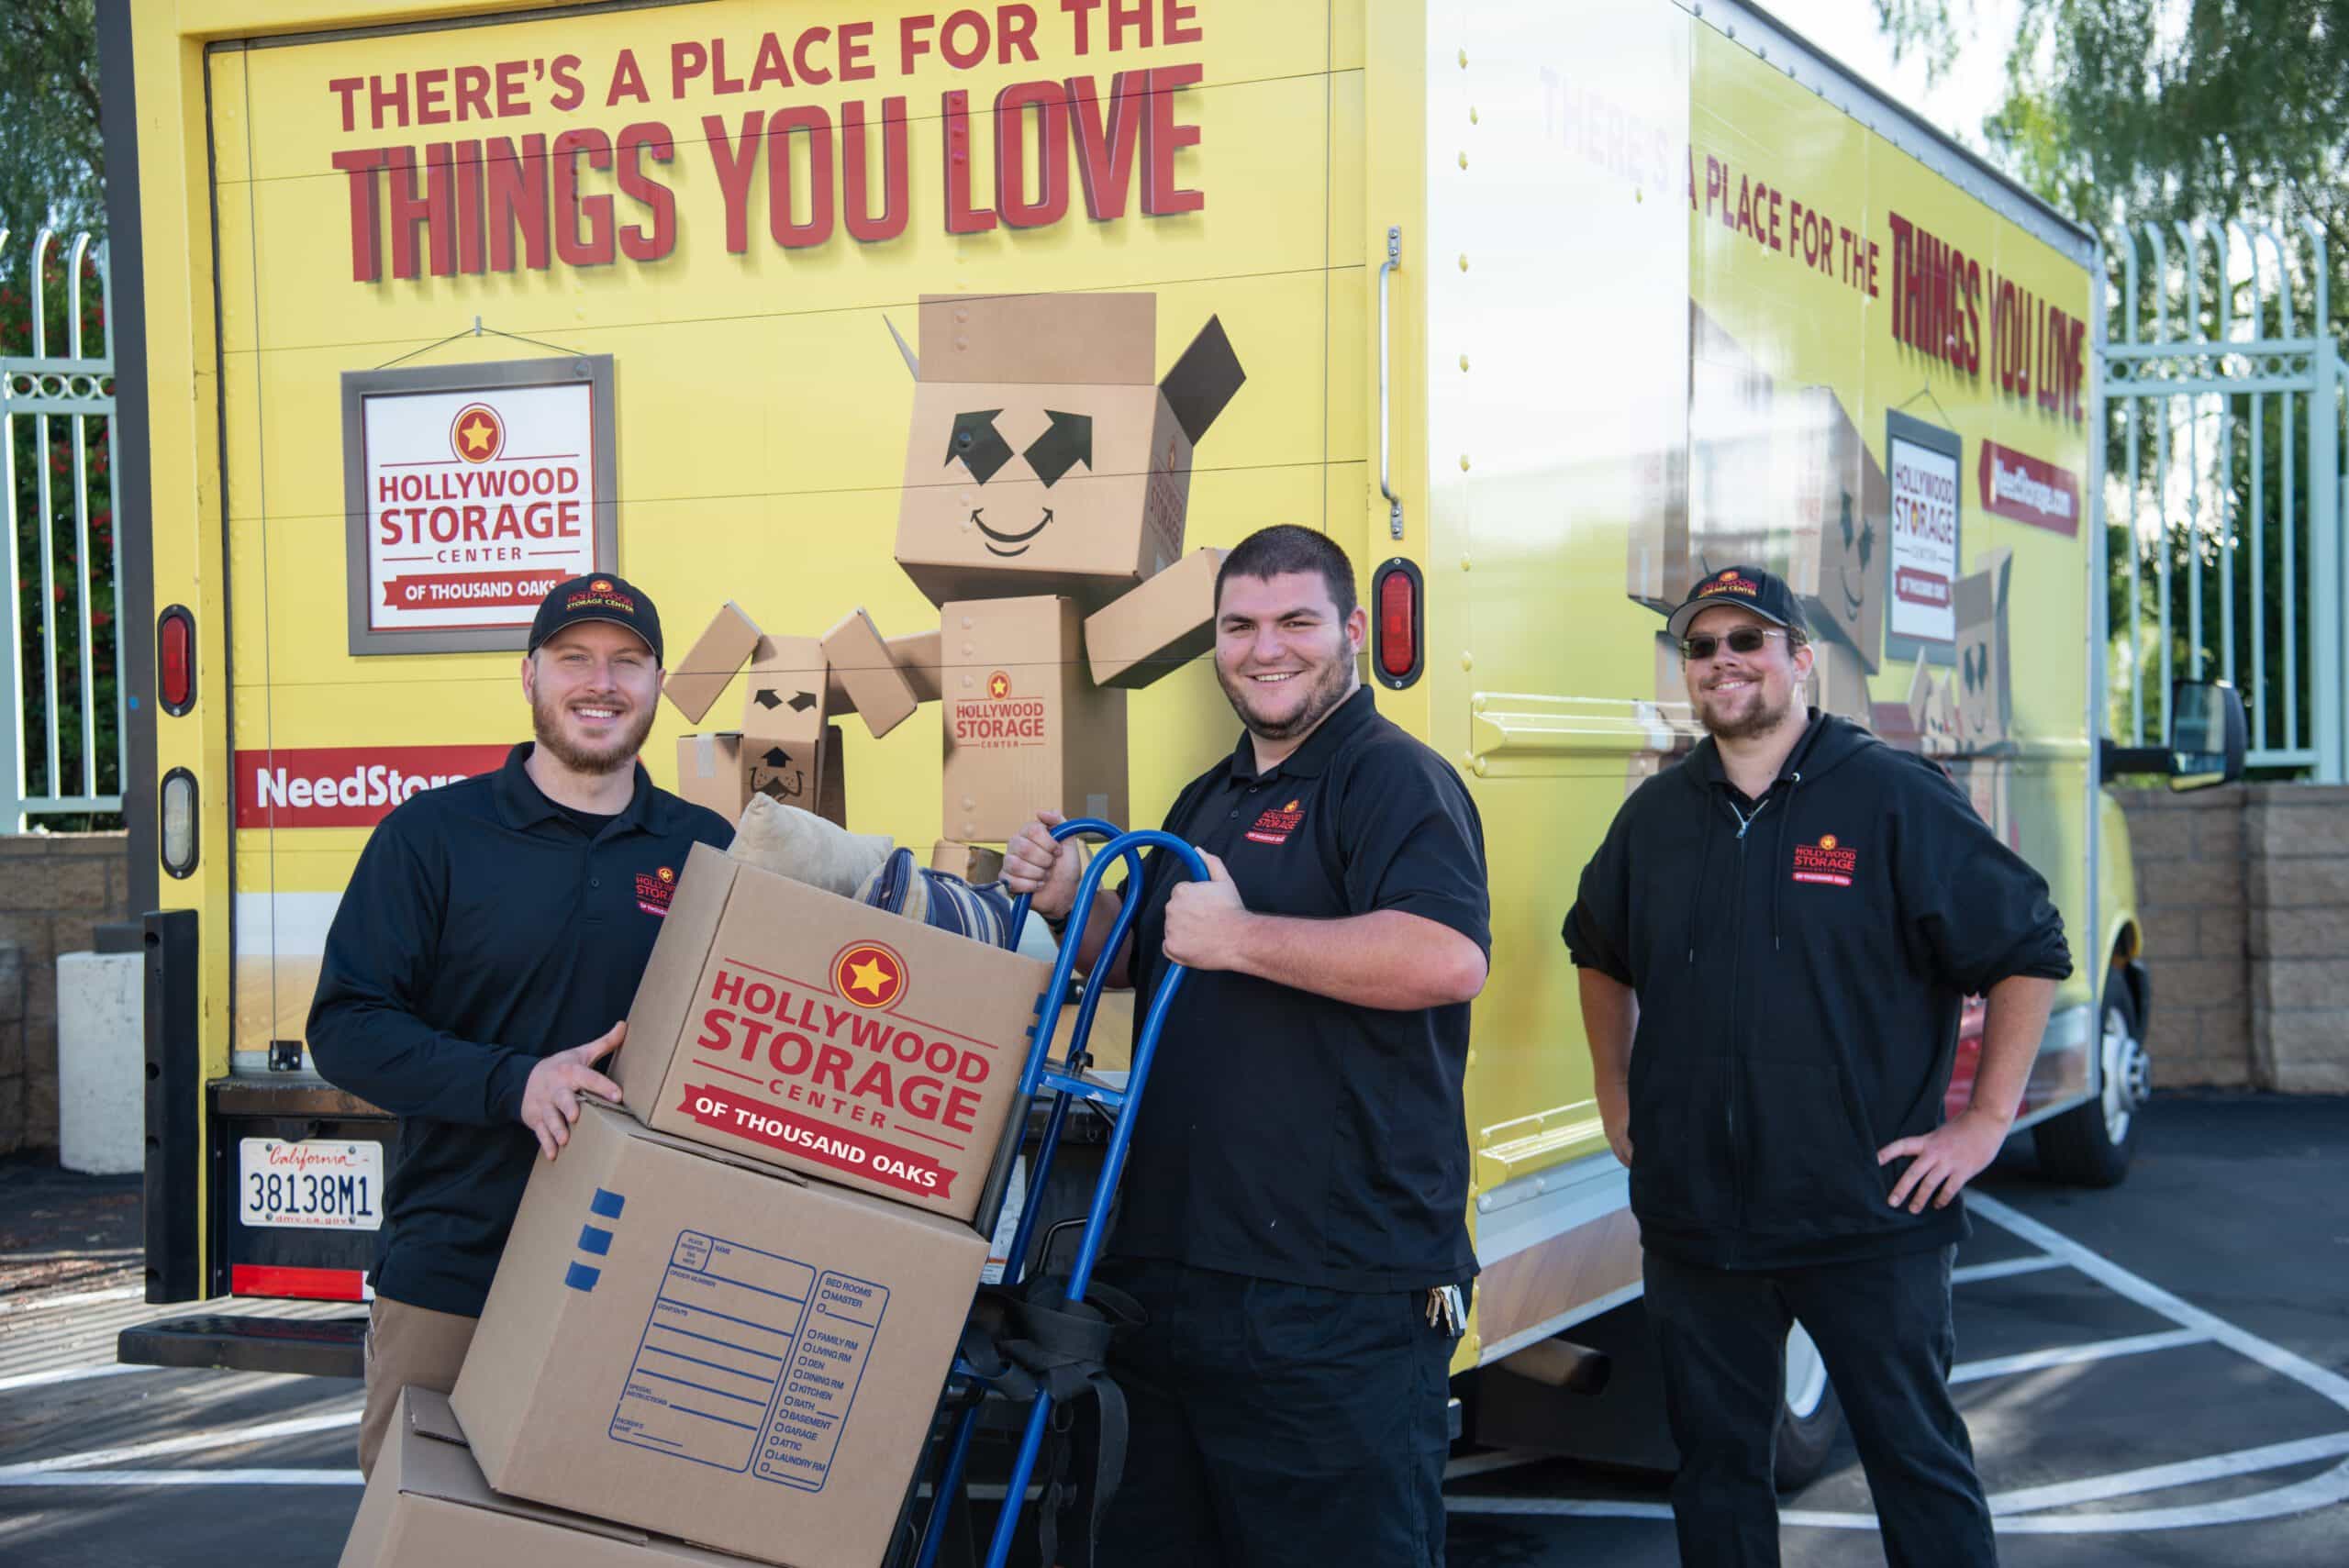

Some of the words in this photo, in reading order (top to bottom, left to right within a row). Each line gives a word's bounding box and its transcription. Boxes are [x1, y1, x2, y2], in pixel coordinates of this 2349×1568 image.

[329, 54, 584, 132] THERE'S
[607, 49, 651, 106] A
[671, 21, 875, 100] PLACE
[900, 4, 1039, 75] FOR
[1061, 0, 1203, 56] THE
[331, 121, 676, 283] THINGS
[701, 95, 909, 254] YOU
[941, 62, 1205, 236] LOVE
[1706, 153, 1782, 251] PLACE
[1789, 199, 1833, 276] FOR
[1840, 226, 1879, 298] THE
[1889, 210, 1981, 376] THINGS
[1988, 268, 2032, 398] YOU
[2037, 298, 2085, 424] LOVE
[379, 466, 579, 503] HOLLYWOOD
[380, 500, 581, 545] STORAGE
[1895, 495, 1953, 544] STORAGE
[437, 547, 522, 563] CENTER
[405, 585, 426, 601] OF
[429, 581, 513, 599] THOUSAND
[956, 703, 1043, 719] HOLLYWOOD
[956, 718, 1044, 739] STORAGE
[981, 740, 1019, 749] CENTER
[1255, 818, 1297, 829] STORAGE
[1795, 855, 1855, 871] STORAGE
[1796, 847, 1856, 860] HOLLYWOOD
[711, 971, 990, 1084] HOLLYWOOD
[696, 1008, 982, 1134] STORAGE
[769, 1079, 887, 1129] CENTER
[696, 1096, 729, 1118] OF
[734, 1107, 866, 1164] THOUSAND
[872, 1155, 938, 1187] OAKS
[270, 1145, 356, 1171] California
[250, 1173, 373, 1216] 38138M1
[275, 1216, 347, 1225] dmv.ca.gov
[826, 1277, 841, 1288] BED
[842, 1283, 873, 1297] ROOMS
[829, 1292, 863, 1307] MASTER
[817, 1332, 845, 1347] FAMILY
[844, 1340, 859, 1351] RM
[812, 1345, 838, 1359] LIVING
[838, 1352, 852, 1363] RM
[808, 1359, 825, 1370] DEN
[803, 1372, 830, 1386] DINING
[830, 1380, 844, 1390] RM
[798, 1385, 833, 1401] KITCHEN
[794, 1398, 815, 1410] BATH
[790, 1411, 832, 1429] BASEMENT
[785, 1426, 818, 1440] GARAGE
[779, 1439, 802, 1451] ATTIC
[774, 1451, 813, 1468] LAUNDRY
[812, 1462, 826, 1472] RM
